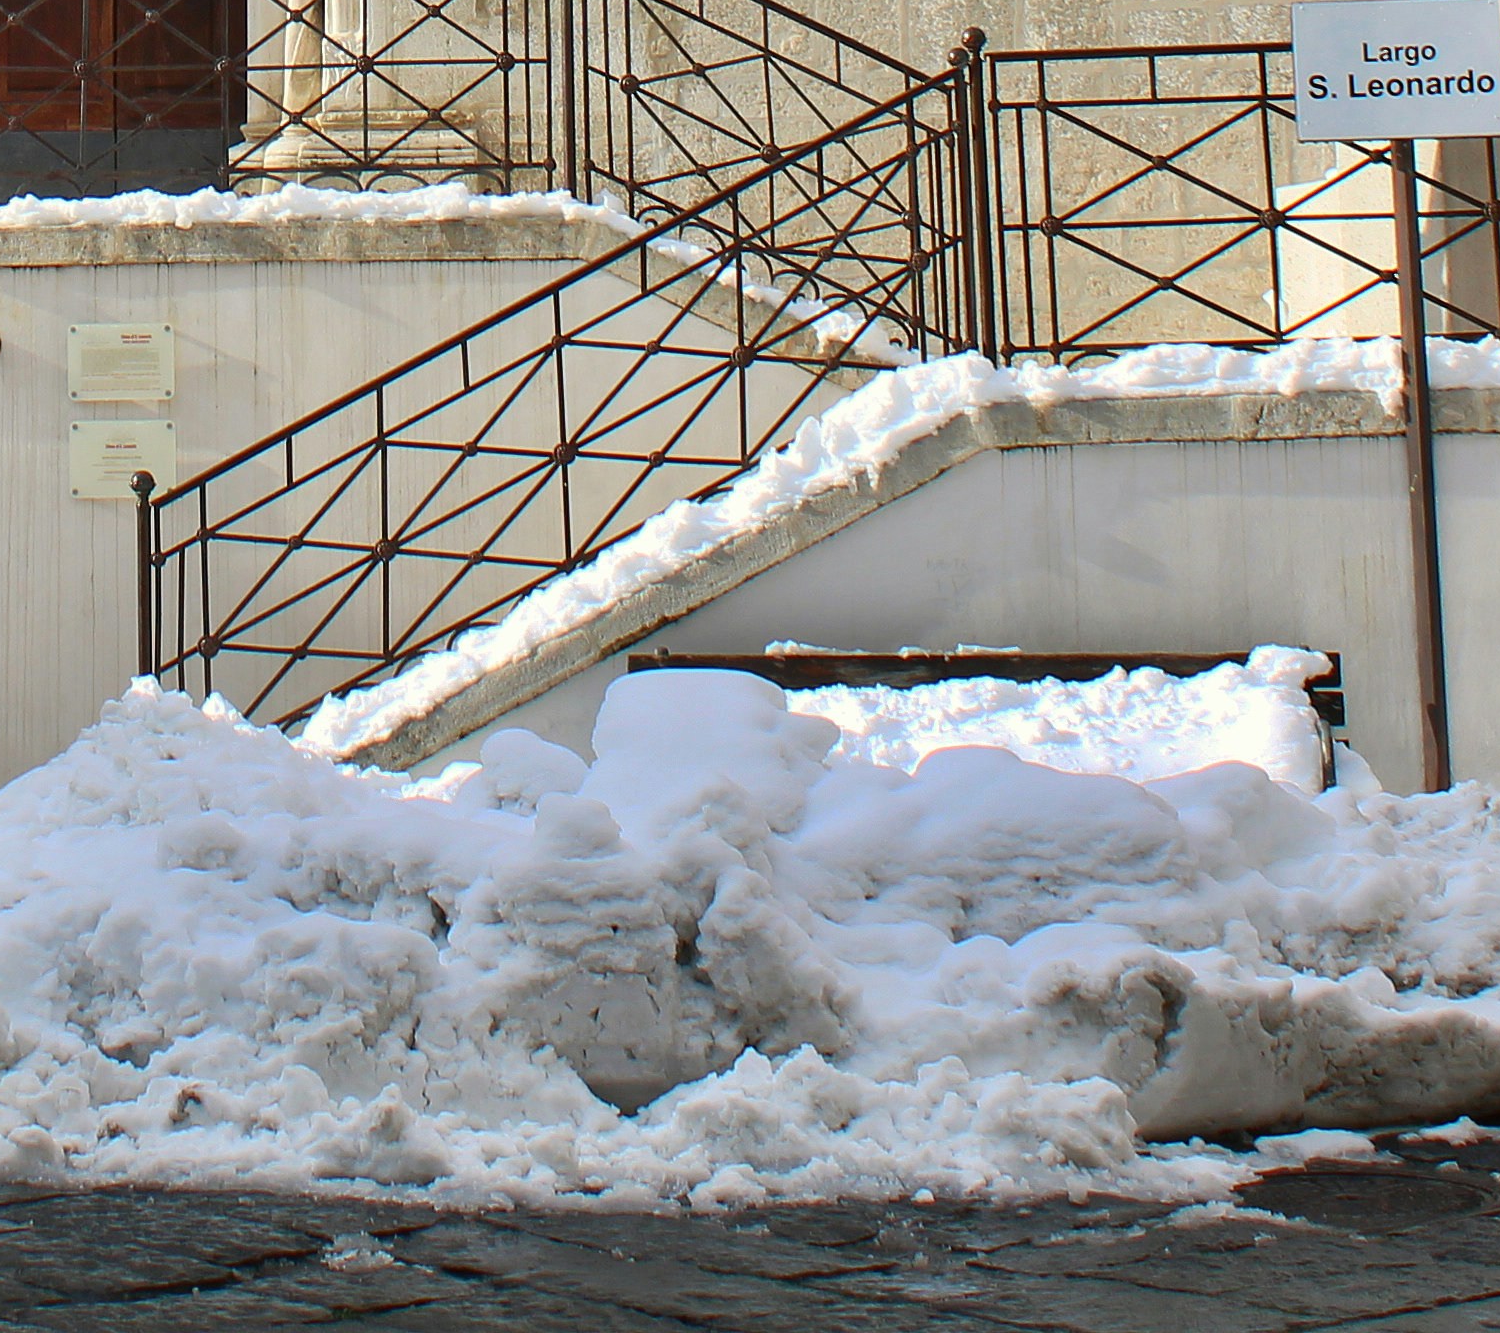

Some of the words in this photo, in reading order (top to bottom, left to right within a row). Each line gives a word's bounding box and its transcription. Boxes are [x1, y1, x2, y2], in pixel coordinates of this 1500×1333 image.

[1362, 42, 1437, 66] Largo
[1308, 74, 1337, 100] S.
[1348, 69, 1496, 98] Leonardo
